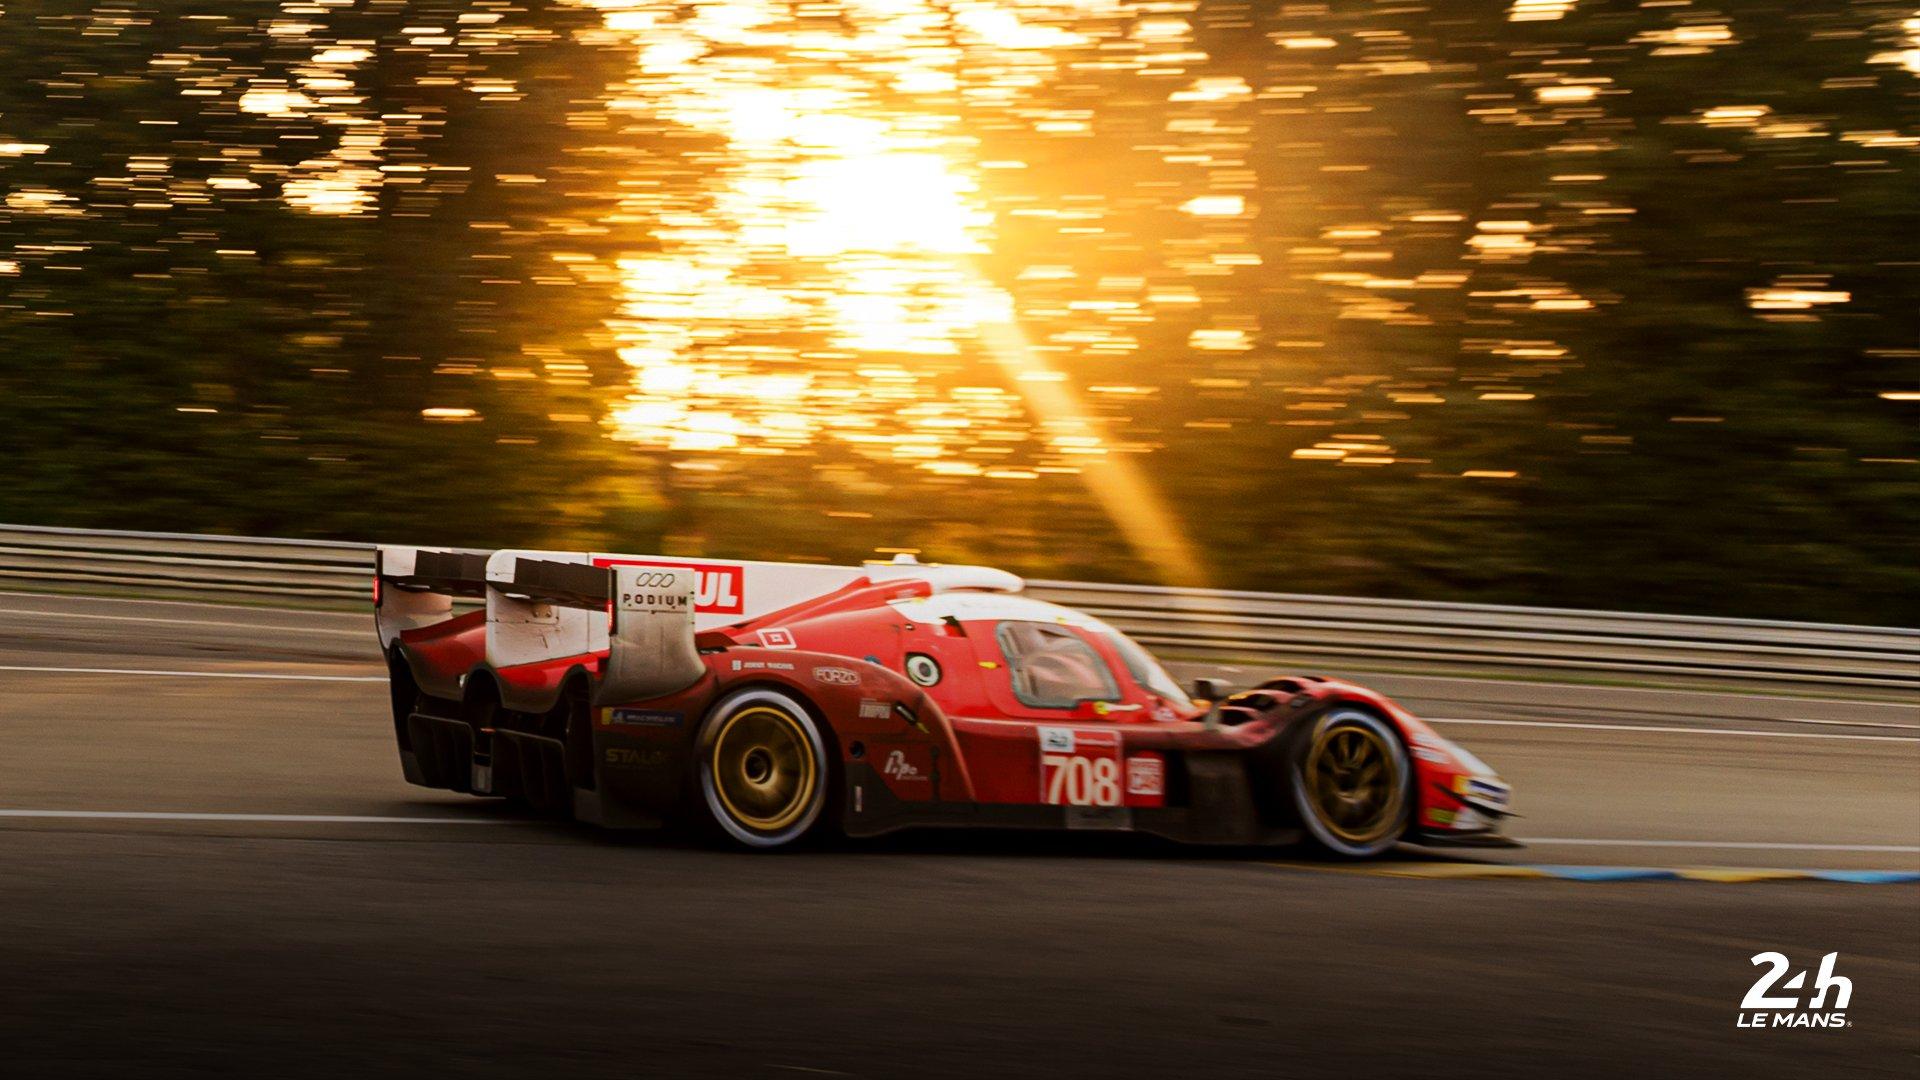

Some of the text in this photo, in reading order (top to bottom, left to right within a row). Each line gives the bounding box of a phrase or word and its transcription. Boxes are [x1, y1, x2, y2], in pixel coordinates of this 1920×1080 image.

[623, 594, 688, 606] PODIUM
[695, 572, 738, 607] UL
[1042, 756, 1119, 806] 708
